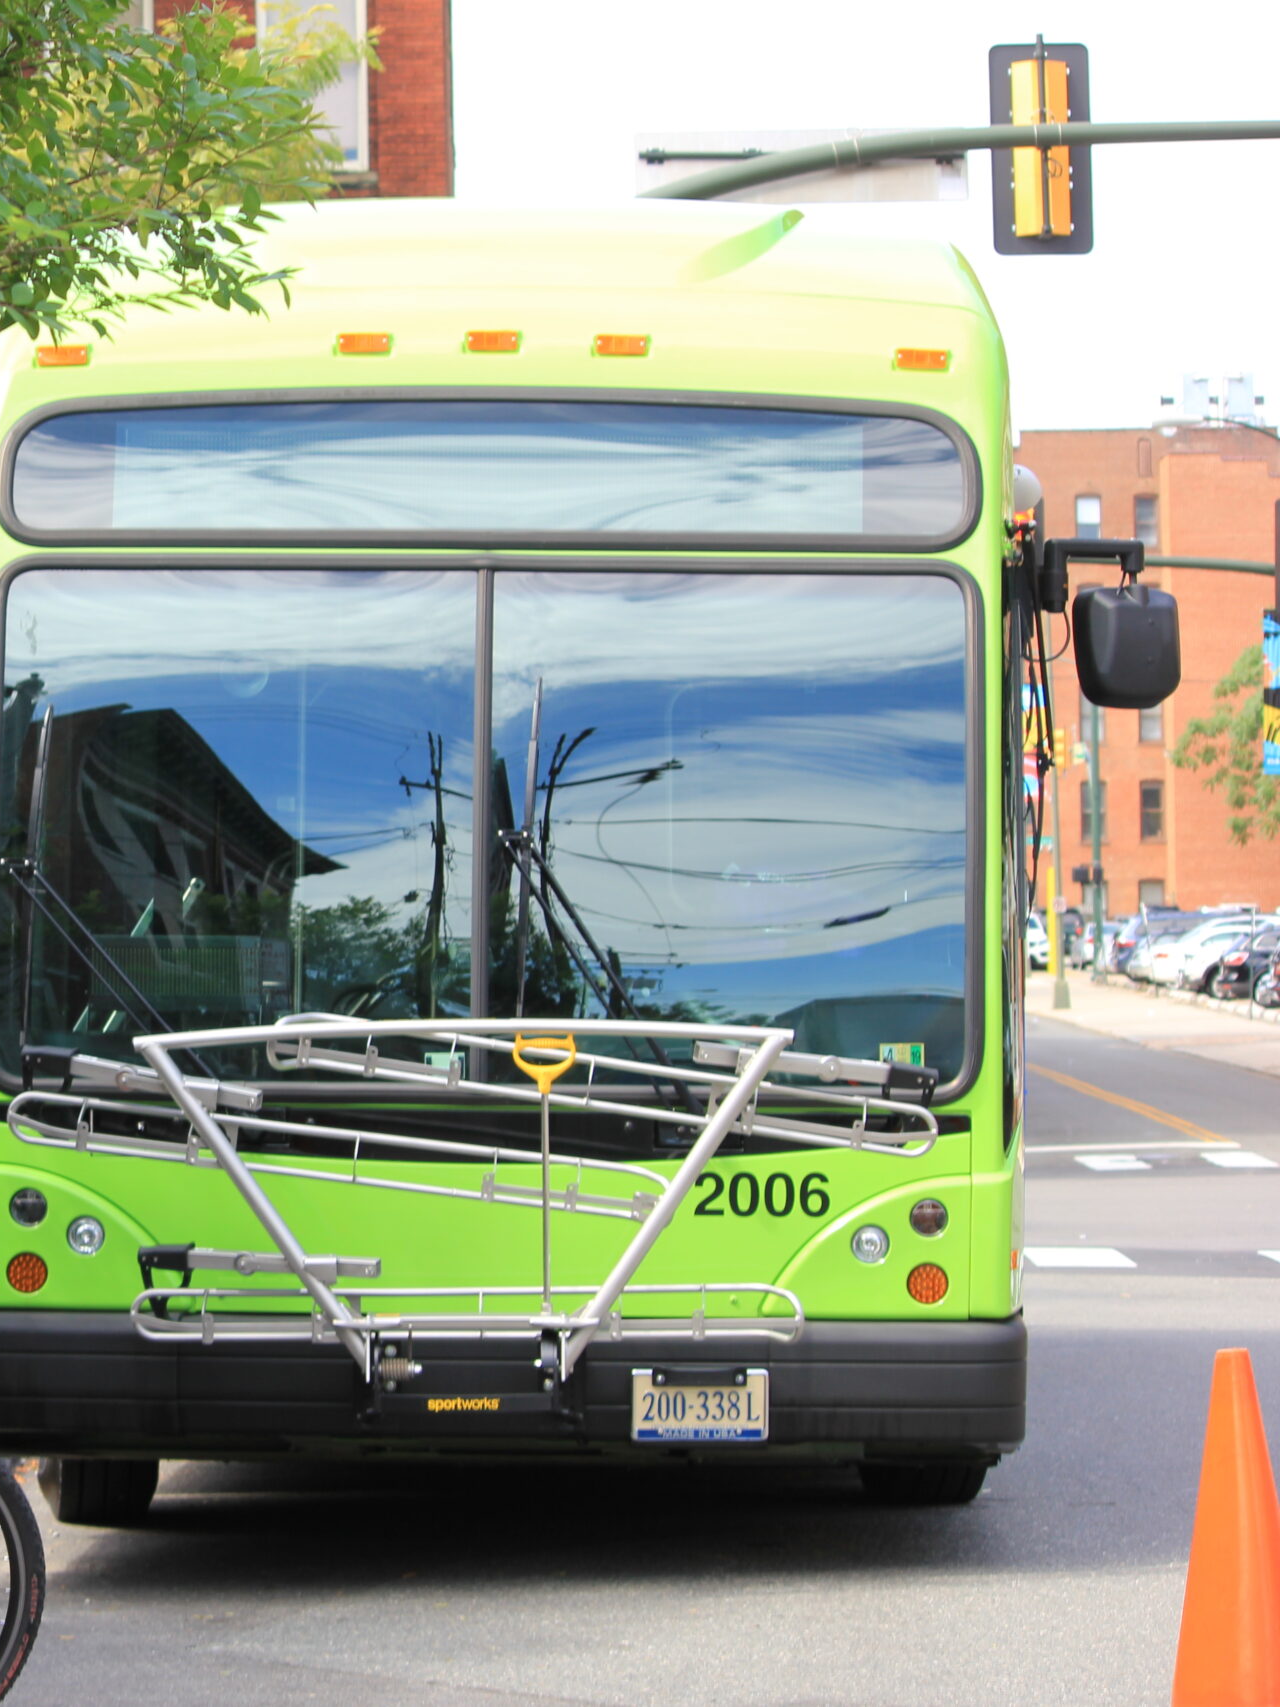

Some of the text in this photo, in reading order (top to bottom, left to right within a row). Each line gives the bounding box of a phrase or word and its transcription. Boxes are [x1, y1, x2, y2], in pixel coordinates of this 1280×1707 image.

[694, 1172, 831, 1217] 2006
[427, 1397, 500, 1413] sportworks
[642, 1390, 760, 1422] 200-338L
